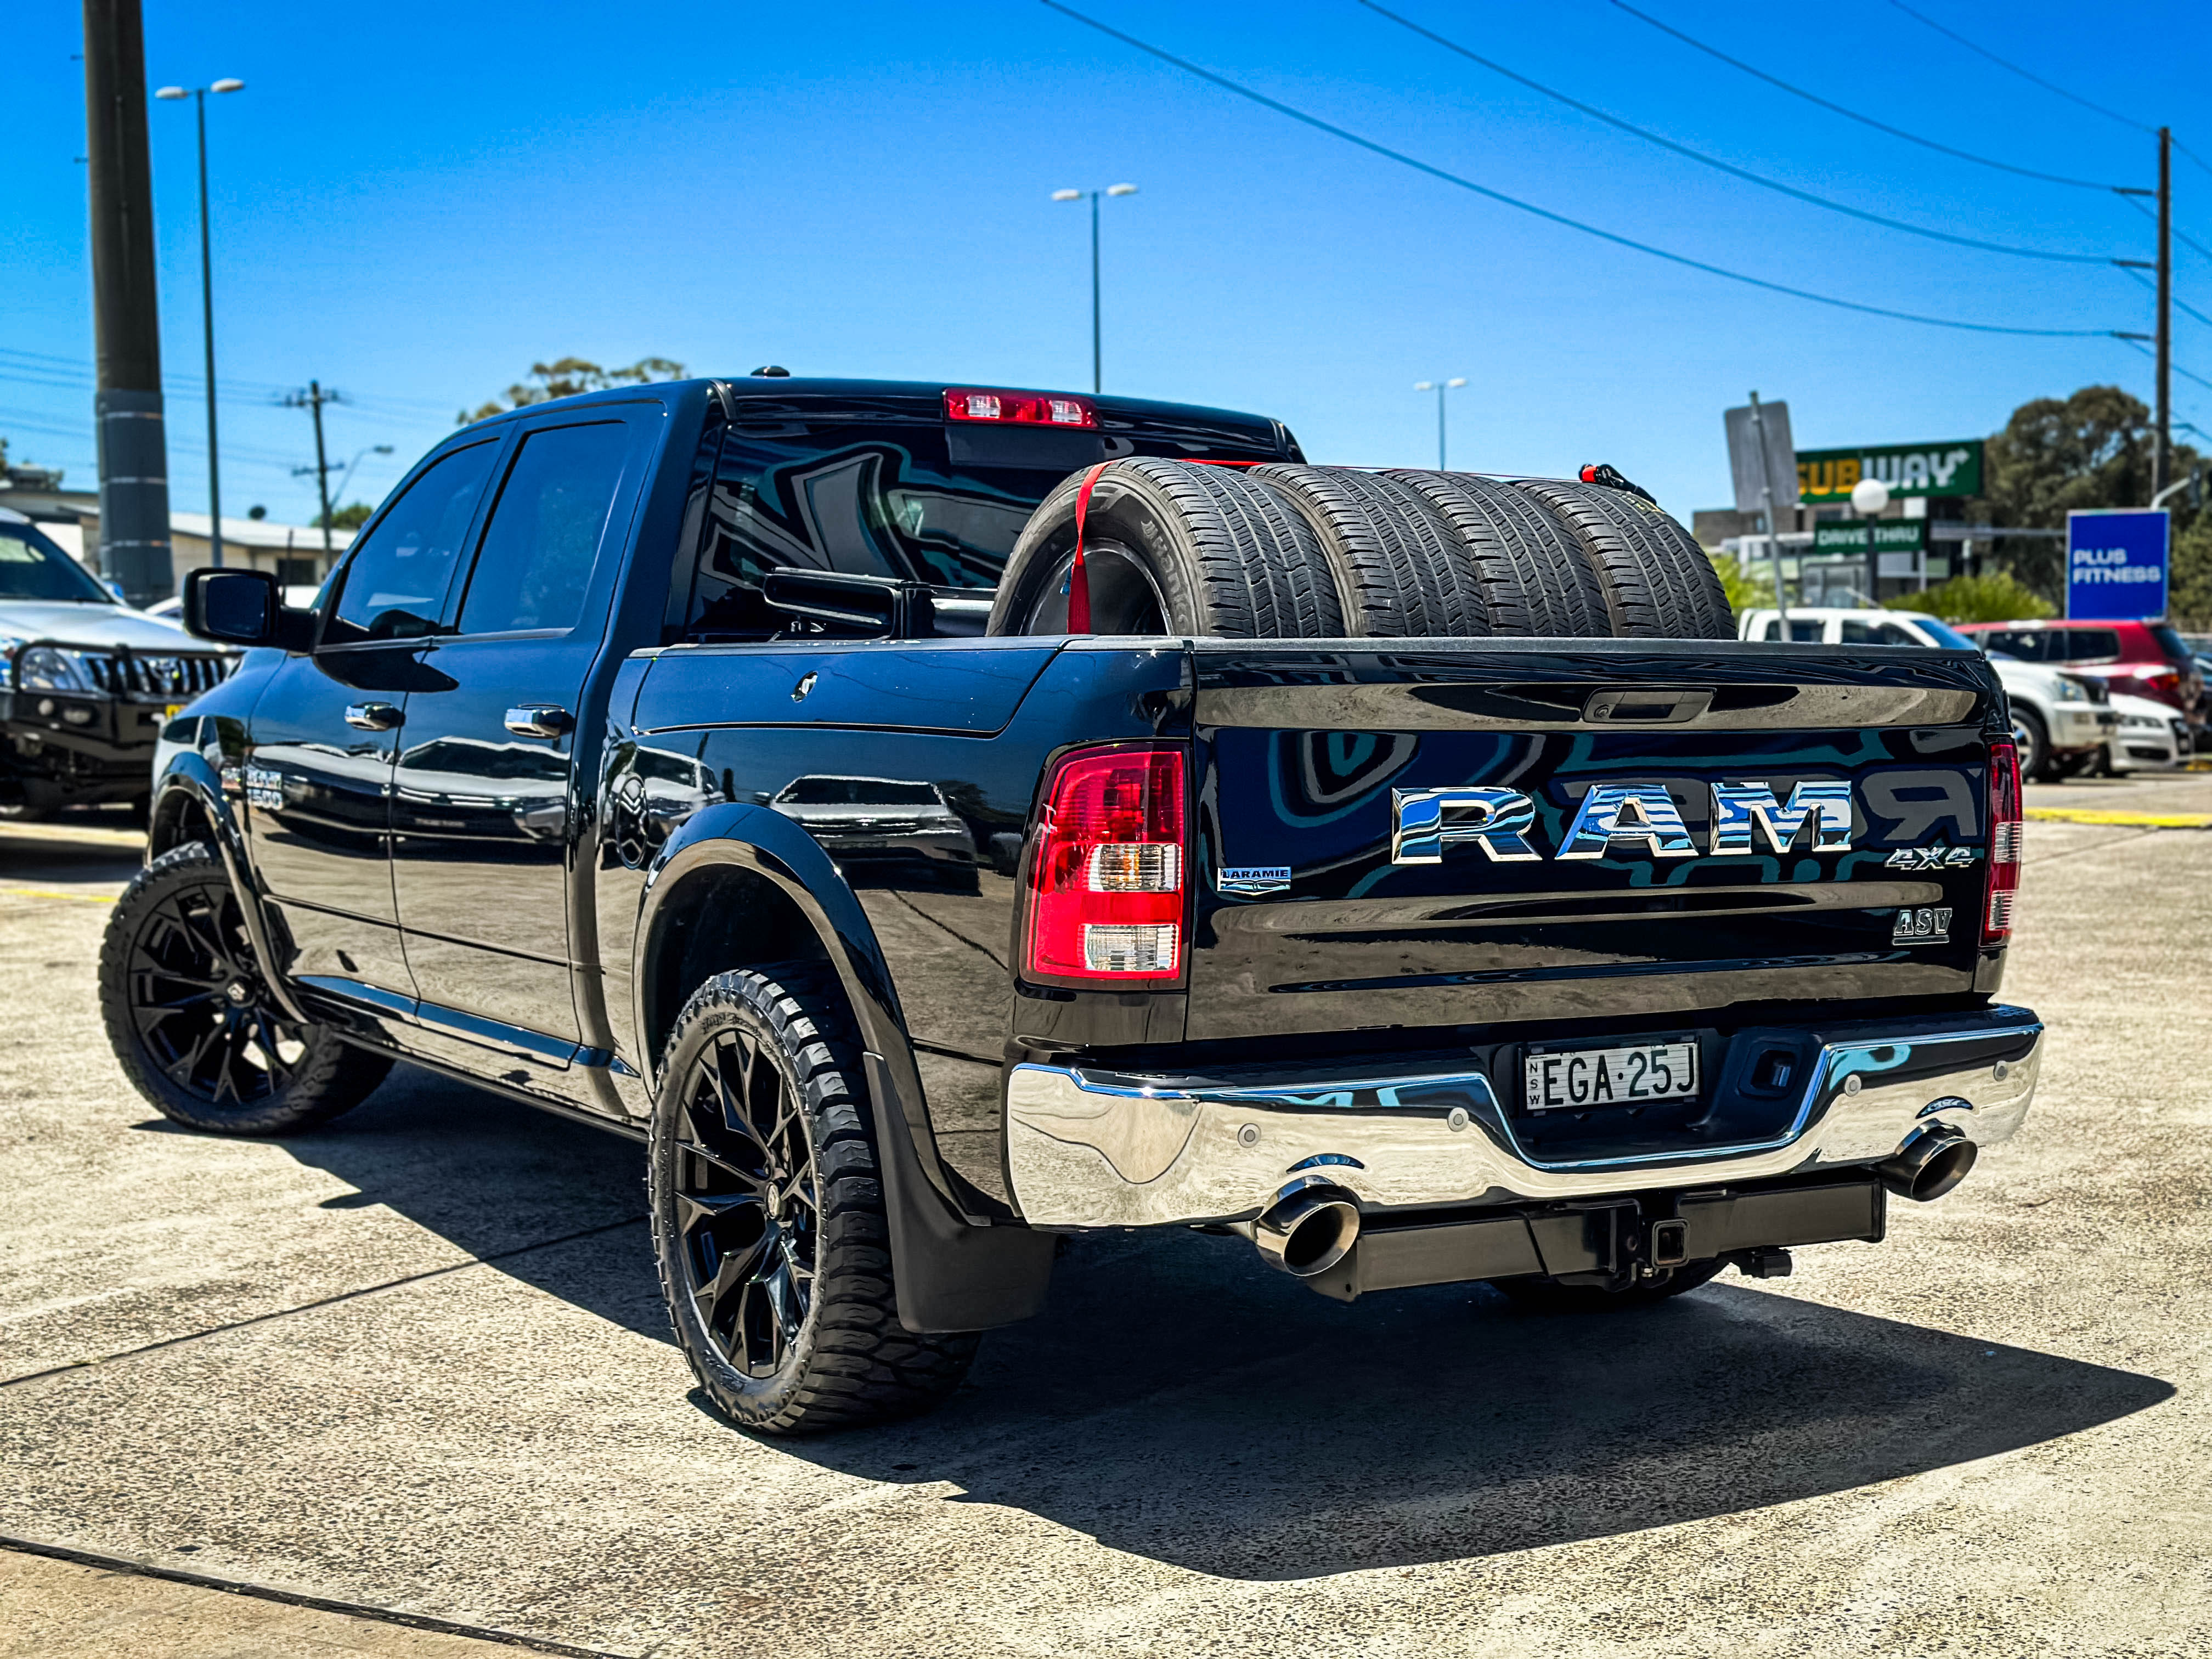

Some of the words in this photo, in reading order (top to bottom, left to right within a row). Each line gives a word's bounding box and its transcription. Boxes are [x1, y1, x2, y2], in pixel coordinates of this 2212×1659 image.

[1818, 529, 1867, 545] DRIVE
[1875, 526, 1918, 543] THRU
[2073, 548, 2127, 565] PLUS
[2073, 566, 2161, 584] FITNESS
[247, 789, 283, 810] 1500
[1392, 781, 1852, 864] RAM
[1222, 870, 1288, 878] LARAMIE
[1893, 907, 1953, 936] ASV
[1529, 1063, 1541, 1105] NSW
